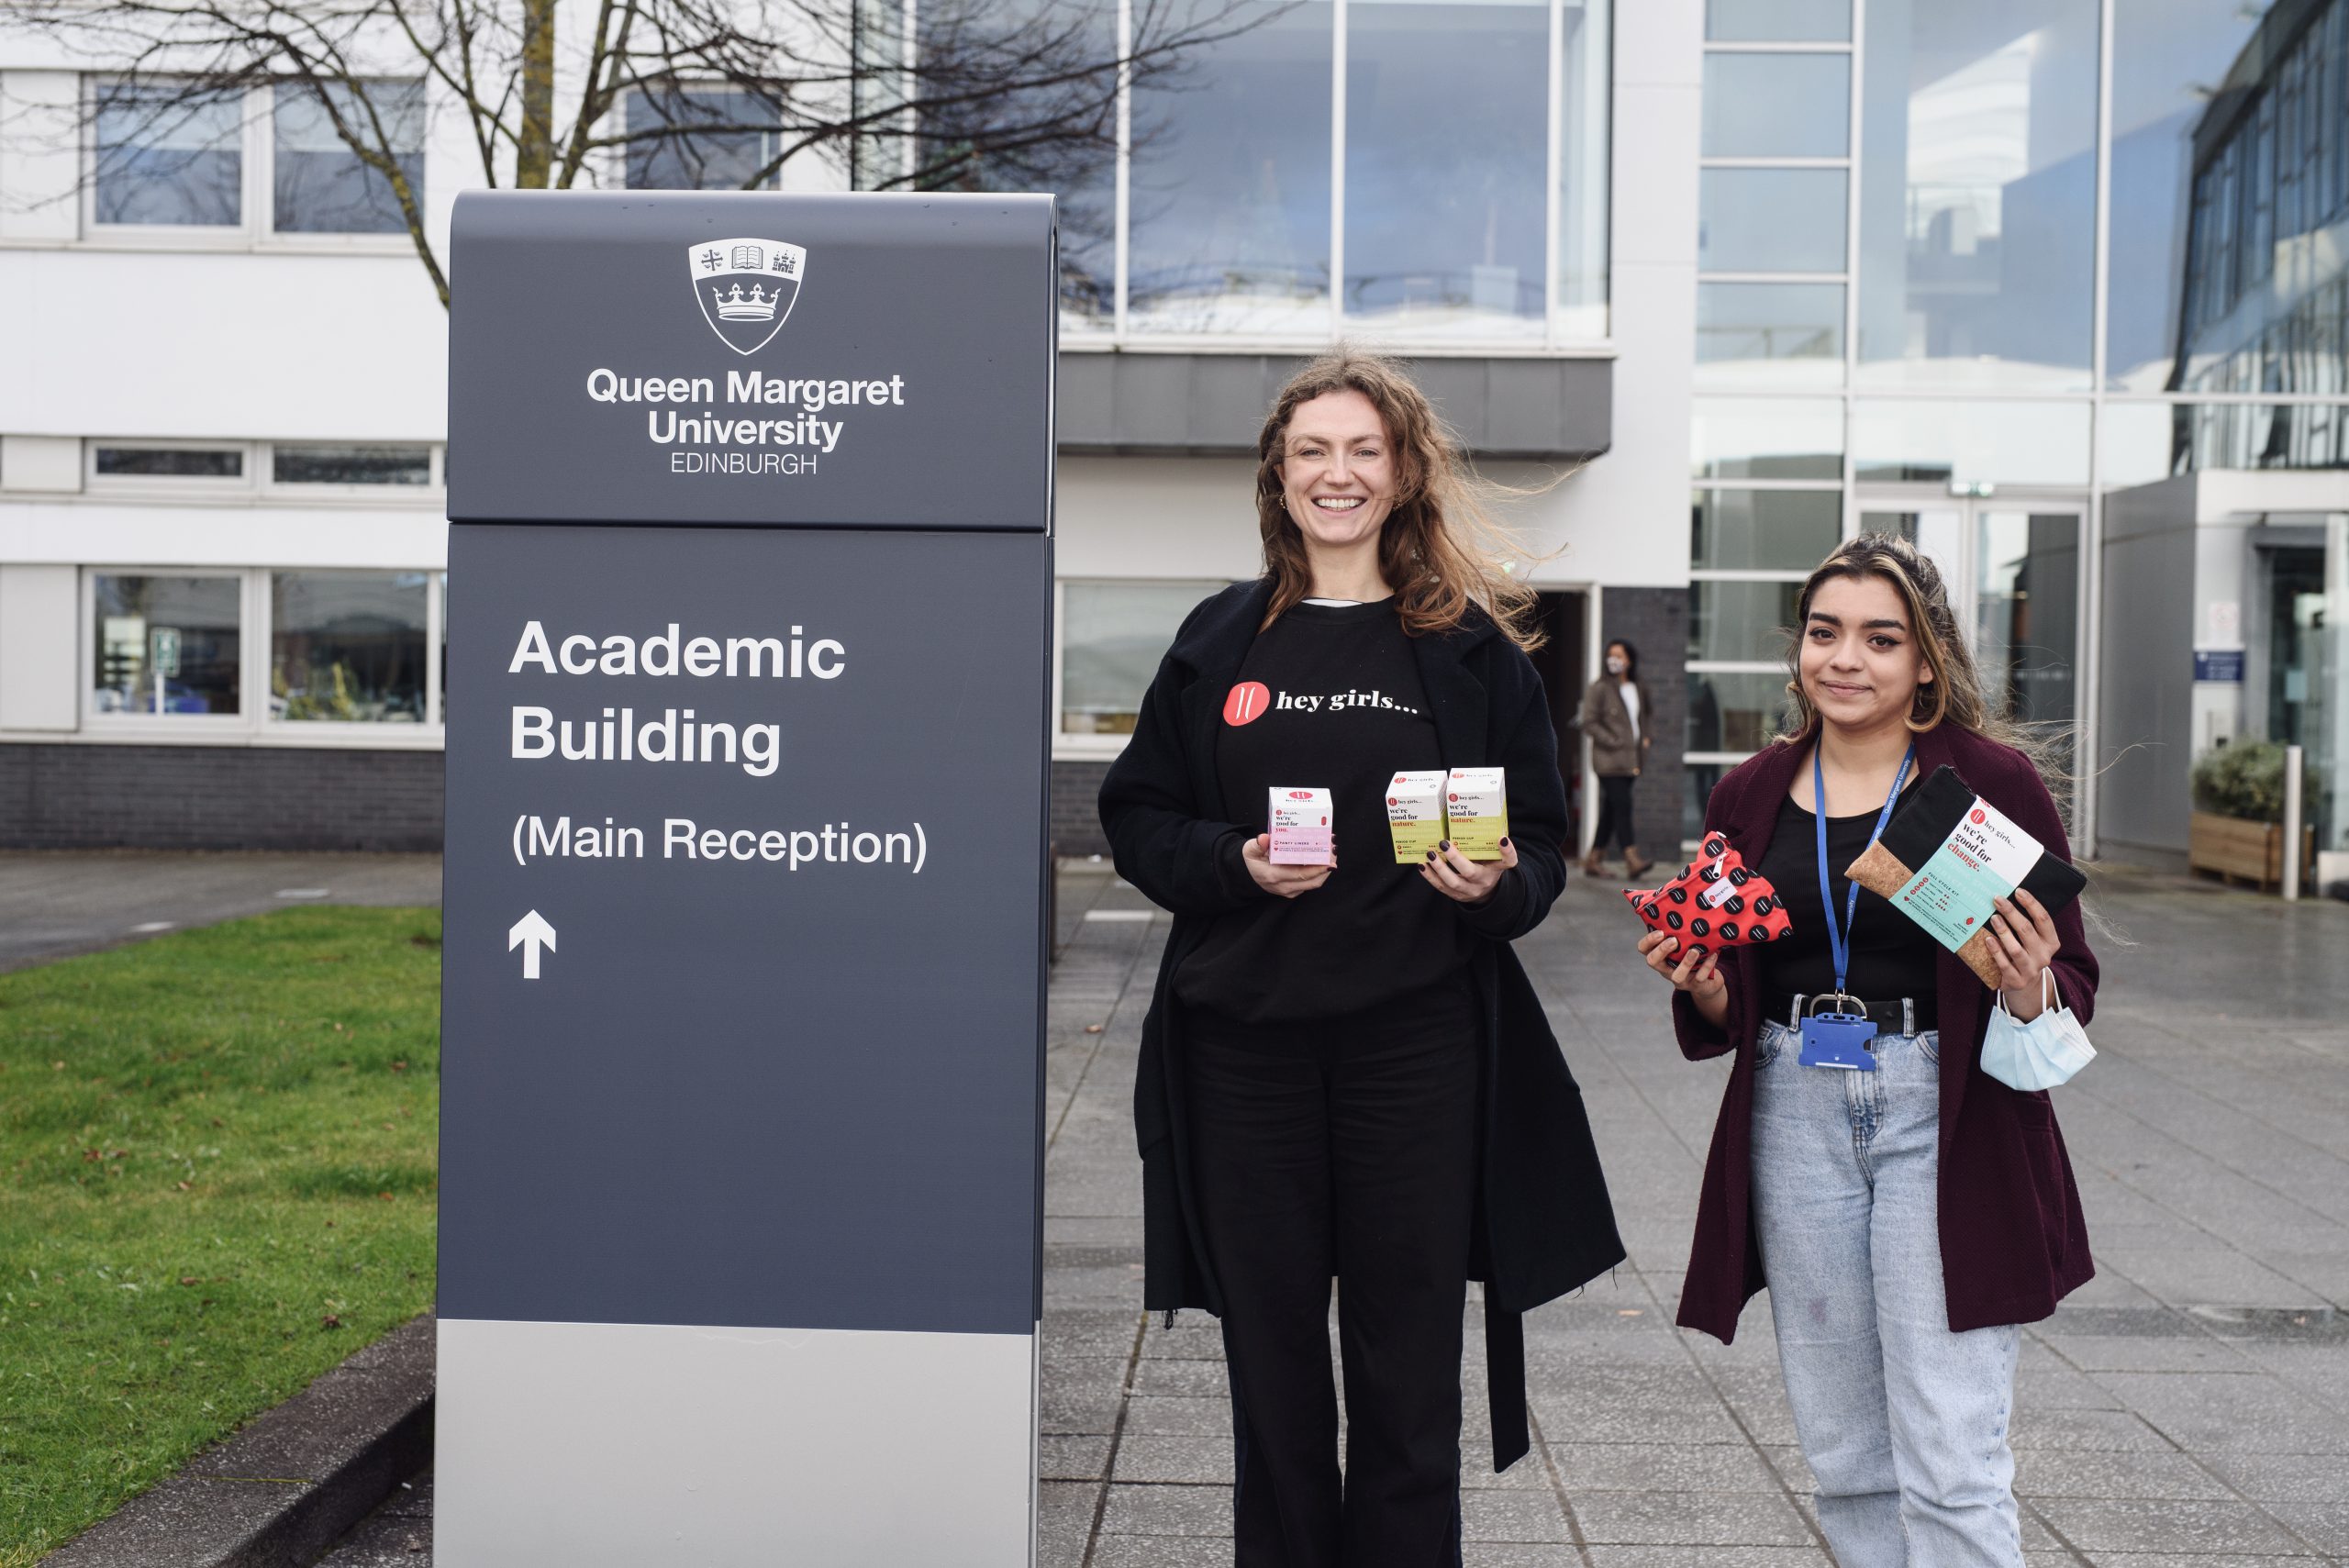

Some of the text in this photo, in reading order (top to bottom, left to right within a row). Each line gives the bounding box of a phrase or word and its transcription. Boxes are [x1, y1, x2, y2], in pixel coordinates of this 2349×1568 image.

[587, 369, 904, 412] Queen Margaret
[649, 411, 843, 451] University
[671, 453, 817, 475] EDINBURGH
[508, 621, 845, 679] Academic
[1275, 689, 1418, 715] hey girls...
[512, 706, 780, 776] Building
[1885, 799, 1894, 814] Queen
[1890, 779, 1902, 799] Margaret
[1963, 824, 1987, 845] we're
[1984, 820, 1995, 833] hey
[514, 816, 928, 873] (Main Reception)
[1947, 843, 1980, 873] change.
[1953, 833, 1991, 863] good for
